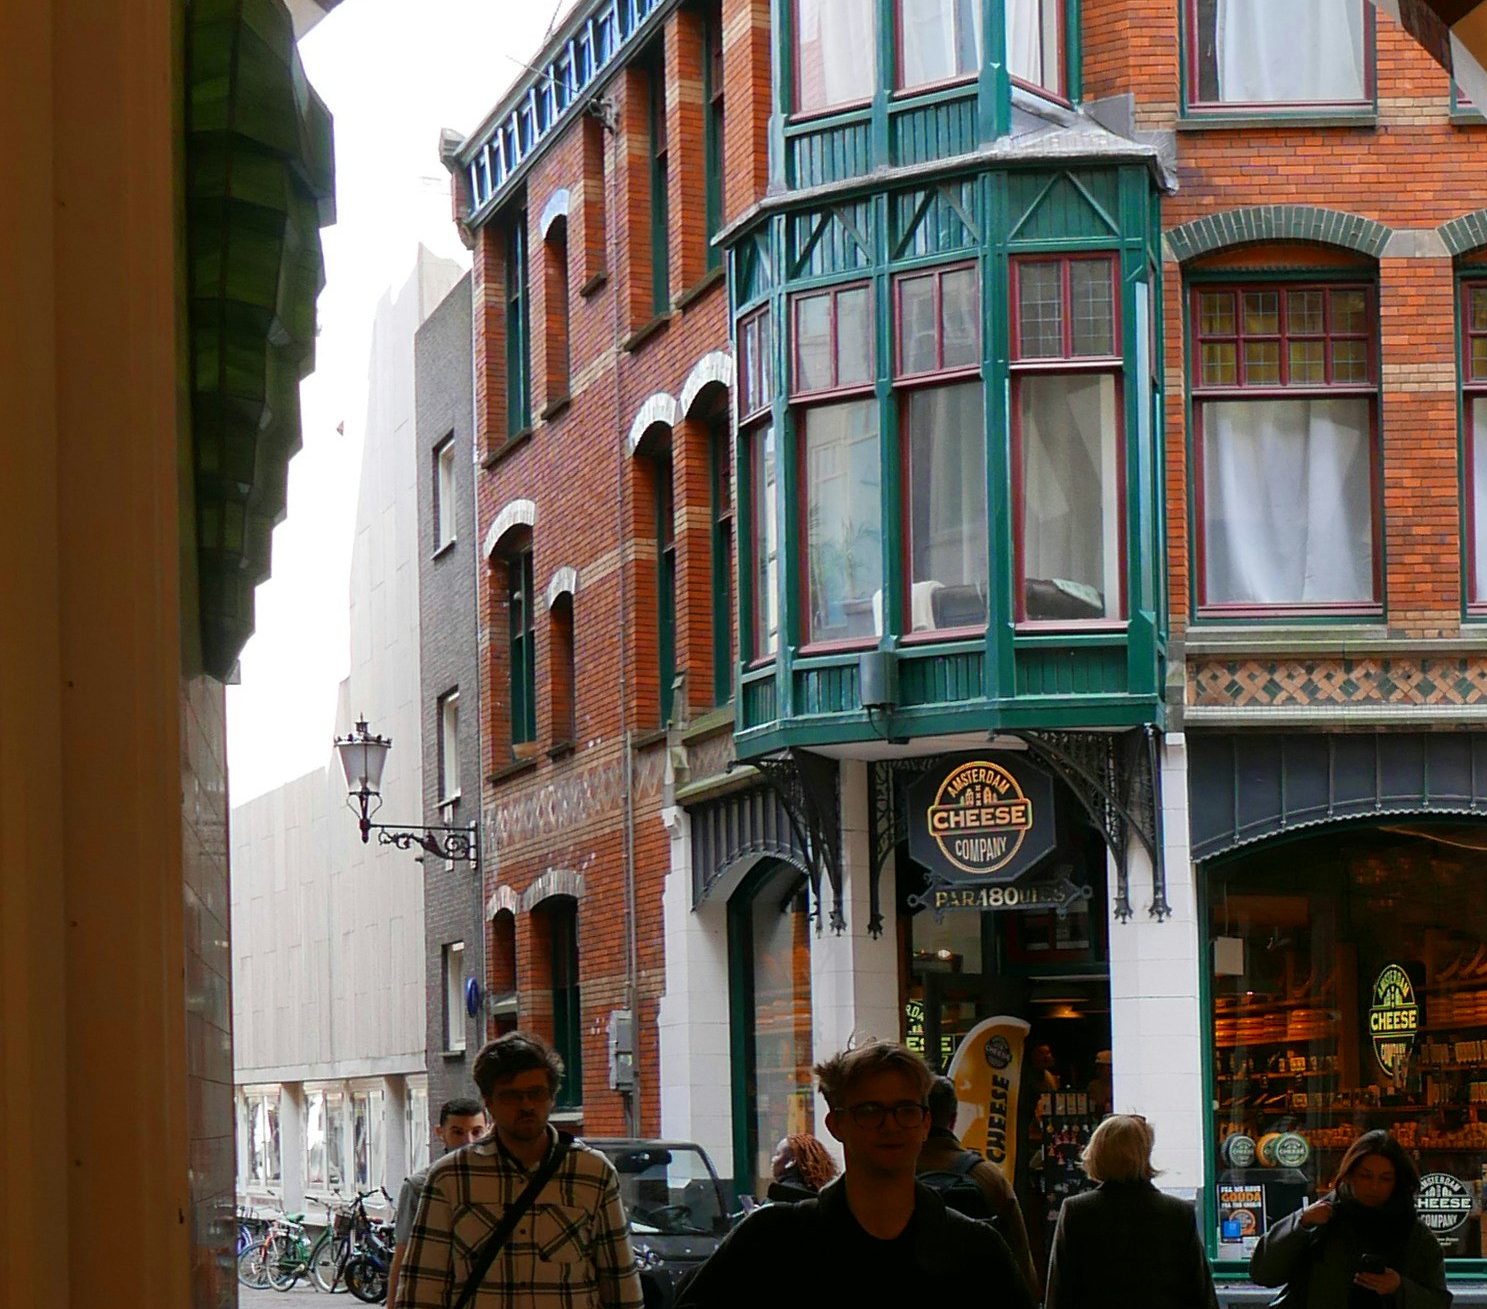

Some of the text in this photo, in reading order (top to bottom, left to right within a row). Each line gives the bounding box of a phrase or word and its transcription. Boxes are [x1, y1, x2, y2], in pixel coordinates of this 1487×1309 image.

[947, 768, 1011, 798] AMSTERDAM
[932, 804, 1026, 830] CHEESE
[955, 836, 1008, 862] COMPANY
[981, 887, 1019, 907] 180
[1370, 1009, 1417, 1031] CHEESE
[986, 1075, 1010, 1163] CHEESE
[1221, 1191, 1262, 1202] GOUDA
[1414, 1197, 1471, 1208] HEESE
